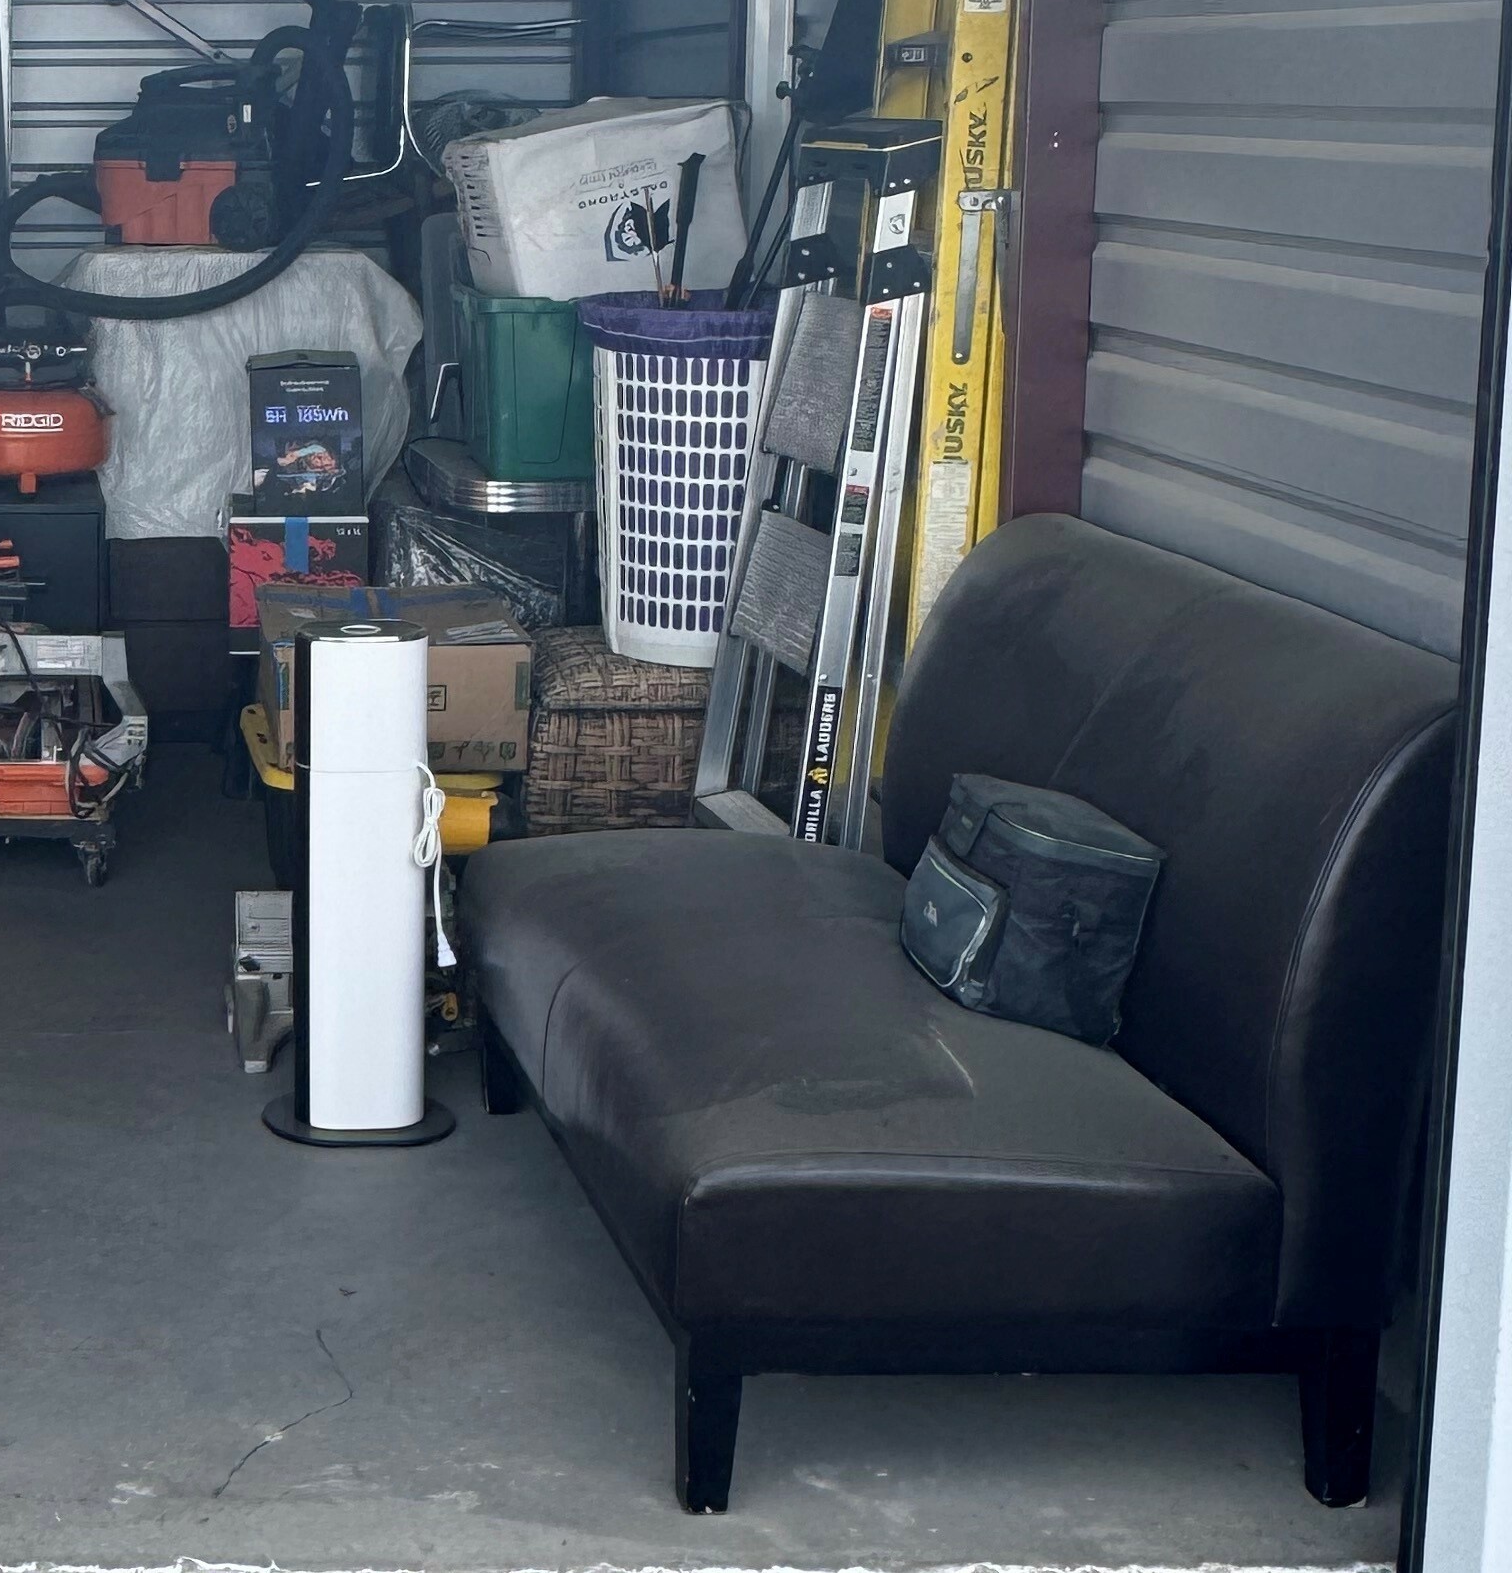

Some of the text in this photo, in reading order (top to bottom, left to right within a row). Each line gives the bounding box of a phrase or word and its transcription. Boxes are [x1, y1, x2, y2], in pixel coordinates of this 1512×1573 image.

[963, 110, 988, 189] USKY
[1, 413, 64, 428] RIDGID
[804, 789, 823, 843] ORILLA
